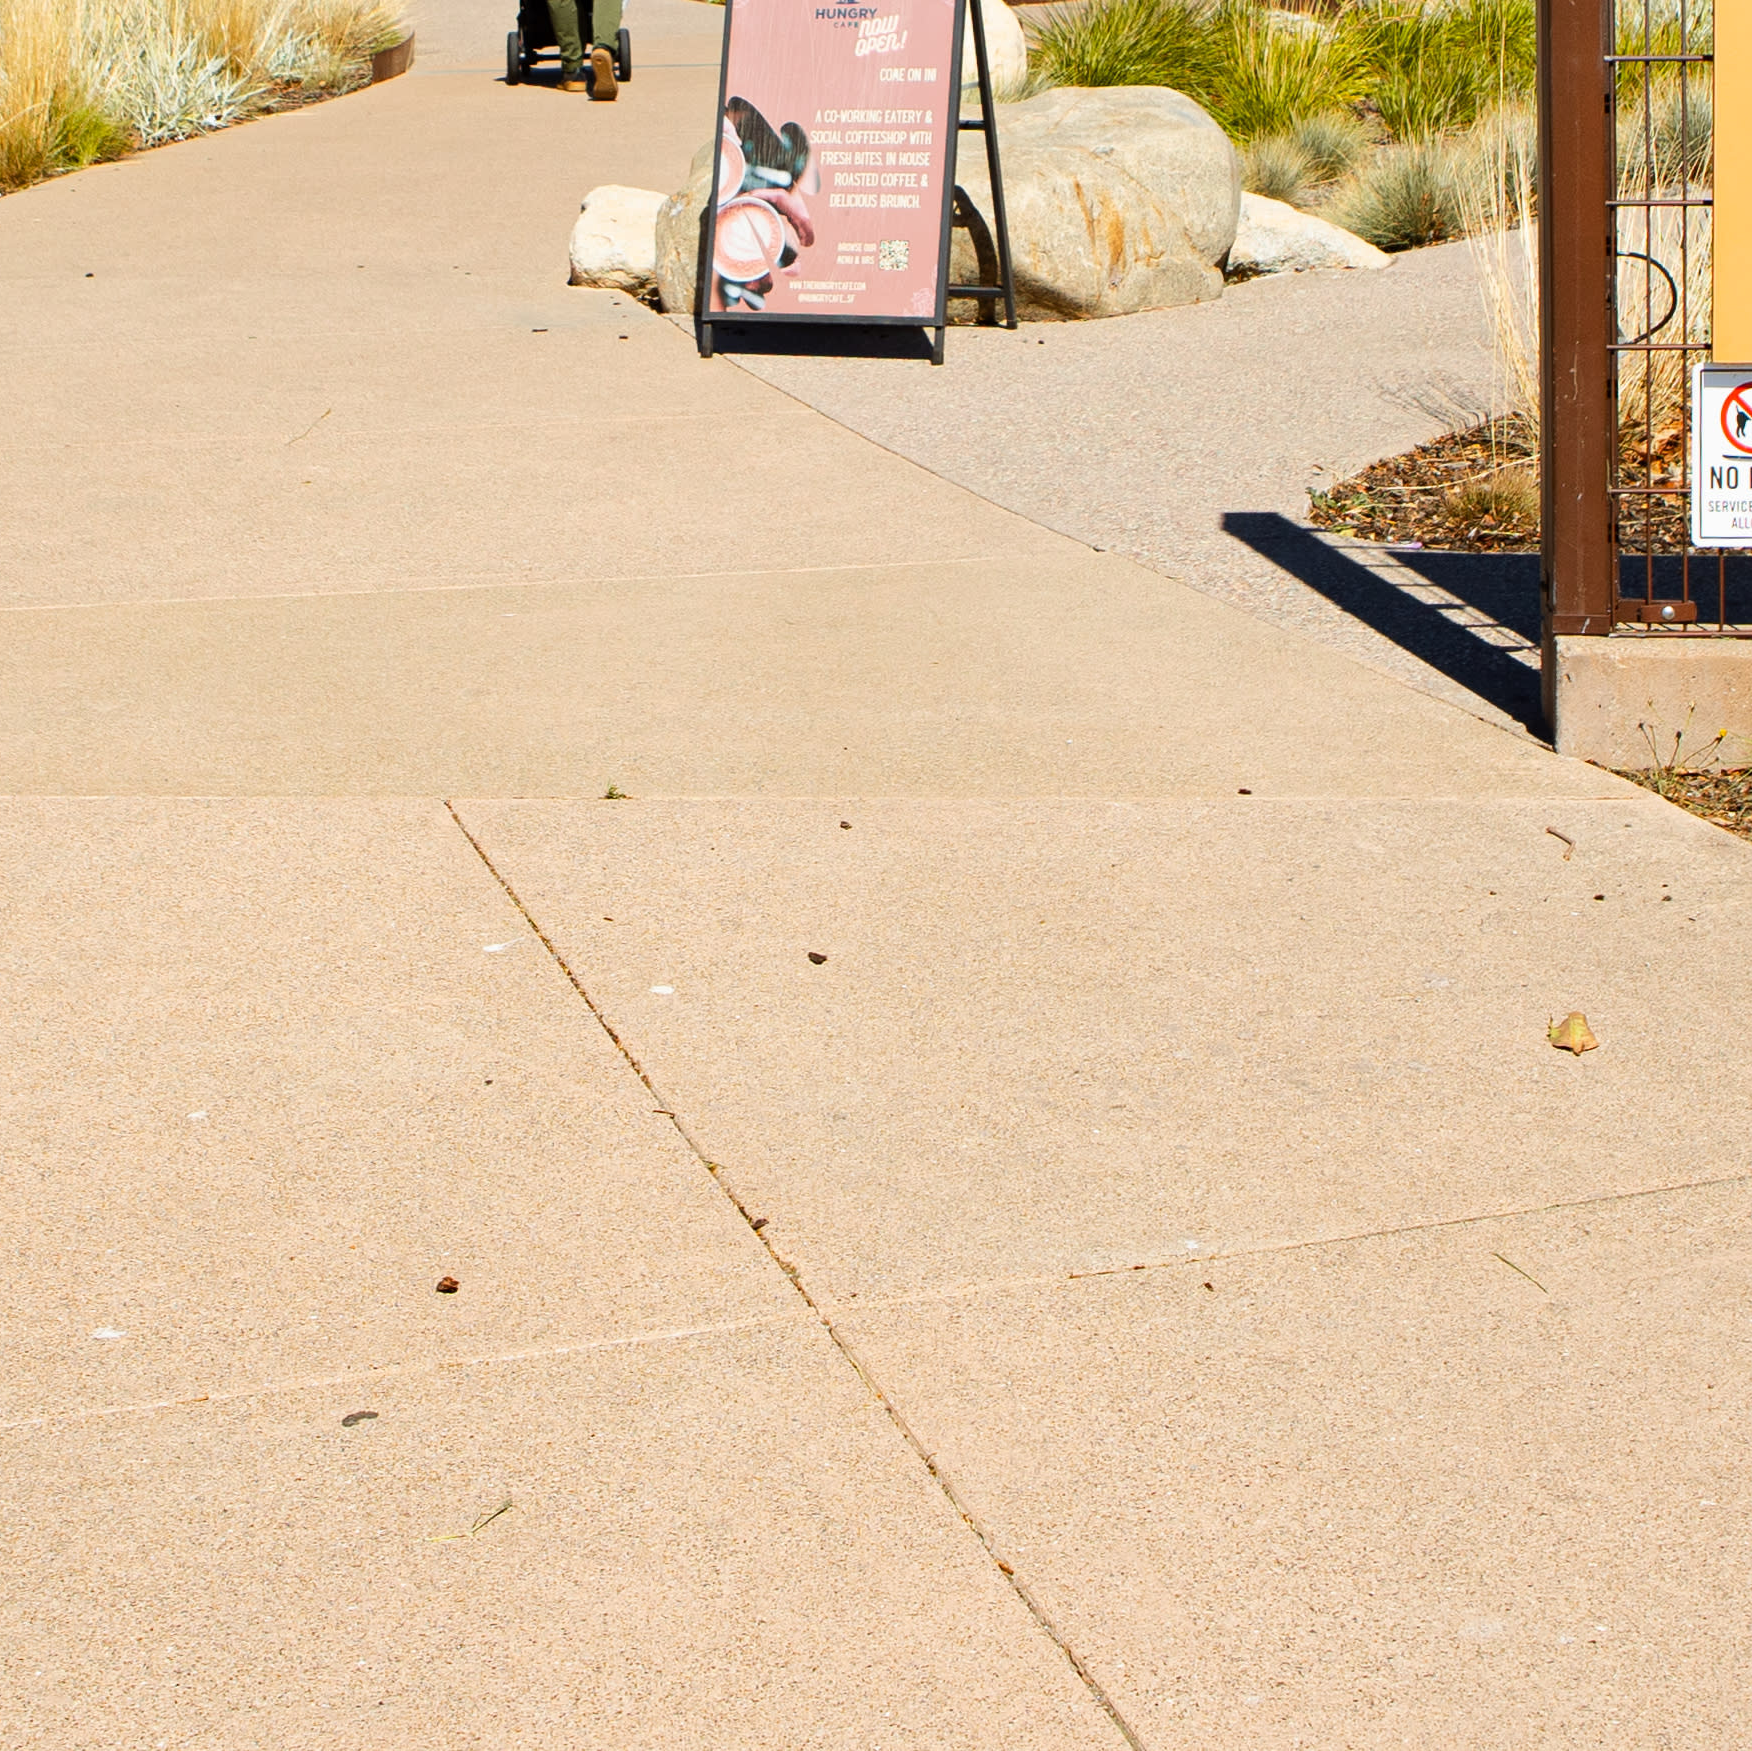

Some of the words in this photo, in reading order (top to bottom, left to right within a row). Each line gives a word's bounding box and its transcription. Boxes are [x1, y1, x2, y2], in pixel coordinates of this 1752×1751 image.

[815, 8, 878, 19] HUNGRY
[833, 21, 859, 29] CAFE
[879, 67, 906, 82] COME
[907, 67, 922, 82] ON
[815, 109, 822, 124] A
[824, 109, 883, 124] CO-WORKING
[884, 109, 923, 124] EATERY
[924, 109, 933, 124] &
[809, 130, 843, 145] SOCIAL
[845, 130, 907, 145] COFFEESHOP
[909, 131, 932, 145] WITH
[820, 151, 852, 165] FRESH
[885, 152, 897, 166] IN
[898, 152, 931, 167] HOUSE
[834, 172, 879, 187] ROASTED
[920, 173, 929, 188] &
[829, 193, 878, 208] DELICIOUS
[1710, 465, 1739, 490] NO
